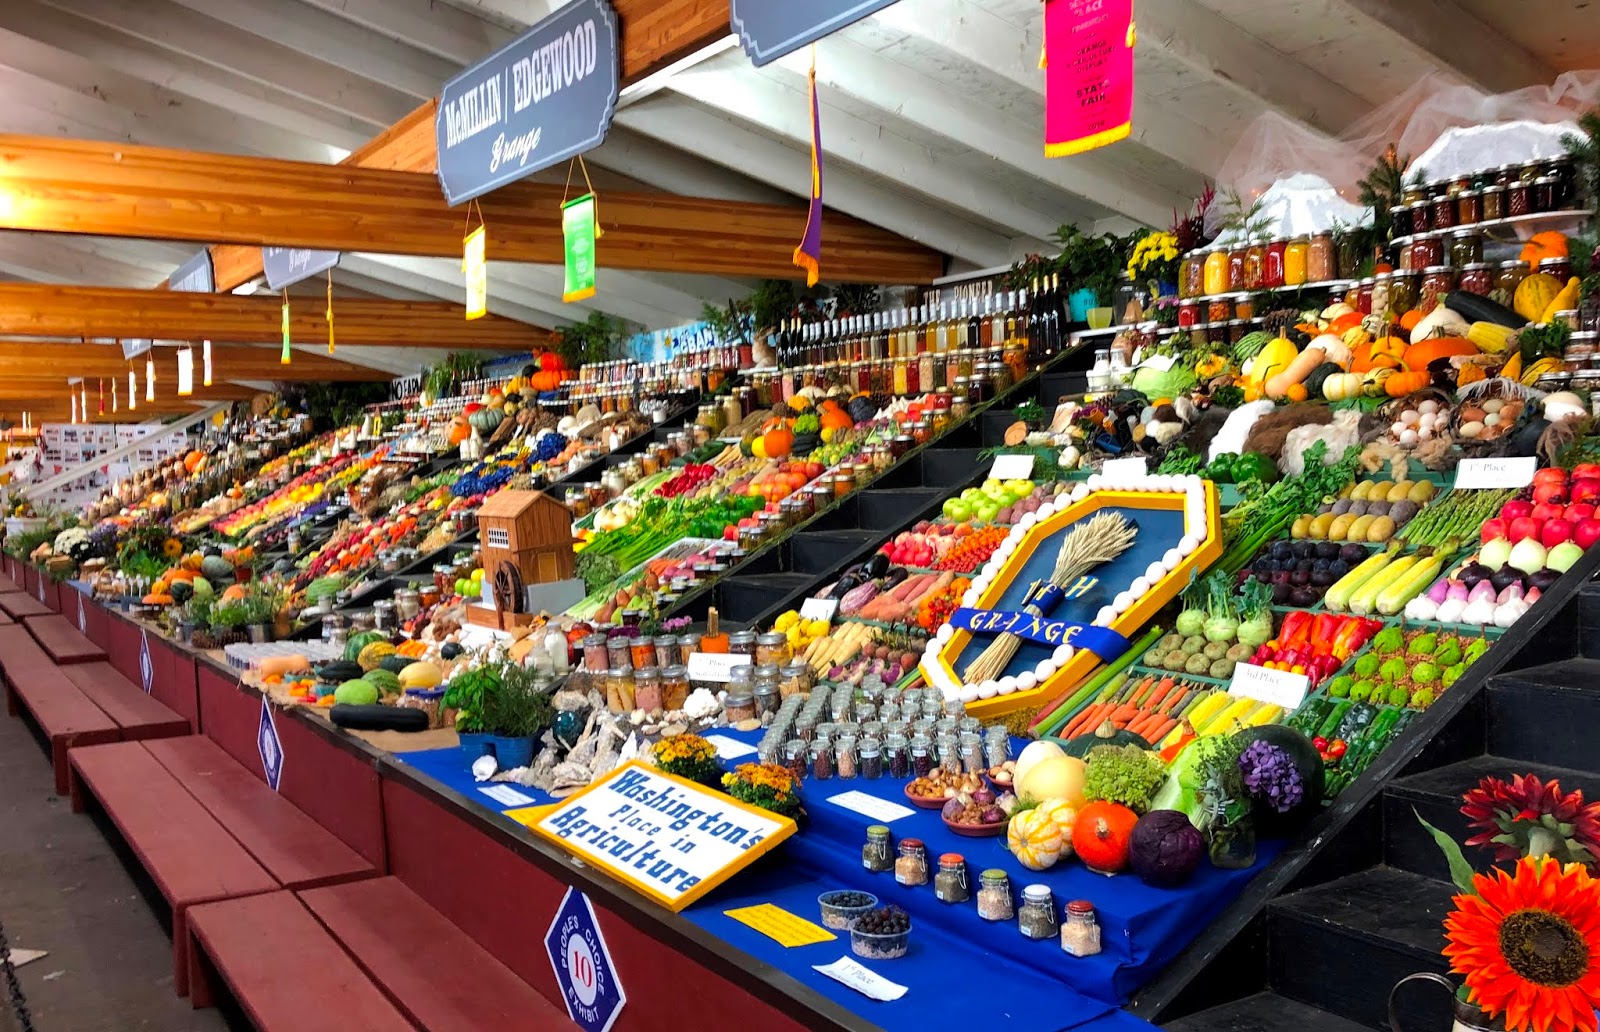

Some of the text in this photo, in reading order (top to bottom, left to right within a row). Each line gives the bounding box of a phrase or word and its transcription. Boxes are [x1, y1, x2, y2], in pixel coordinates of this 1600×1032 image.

[444, 74, 501, 149] McMILLIN
[512, 19, 597, 113] EDGEWOOD
[1076, 79, 1111, 98] STATE
[1081, 92, 1106, 107] FAIR
[490, 127, 542, 174] Grange
[923, 280, 993, 311] THE PIONEER
[969, 611, 1083, 644] GRANGE
[608, 769, 765, 851] Washington's
[608, 803, 697, 855] Place in
[549, 805, 702, 893] Agriculture
[560, 914, 605, 997] PEOPLE'S CHOICE
[573, 950, 593, 988] 10
[568, 985, 600, 1024] EXHIBIT
